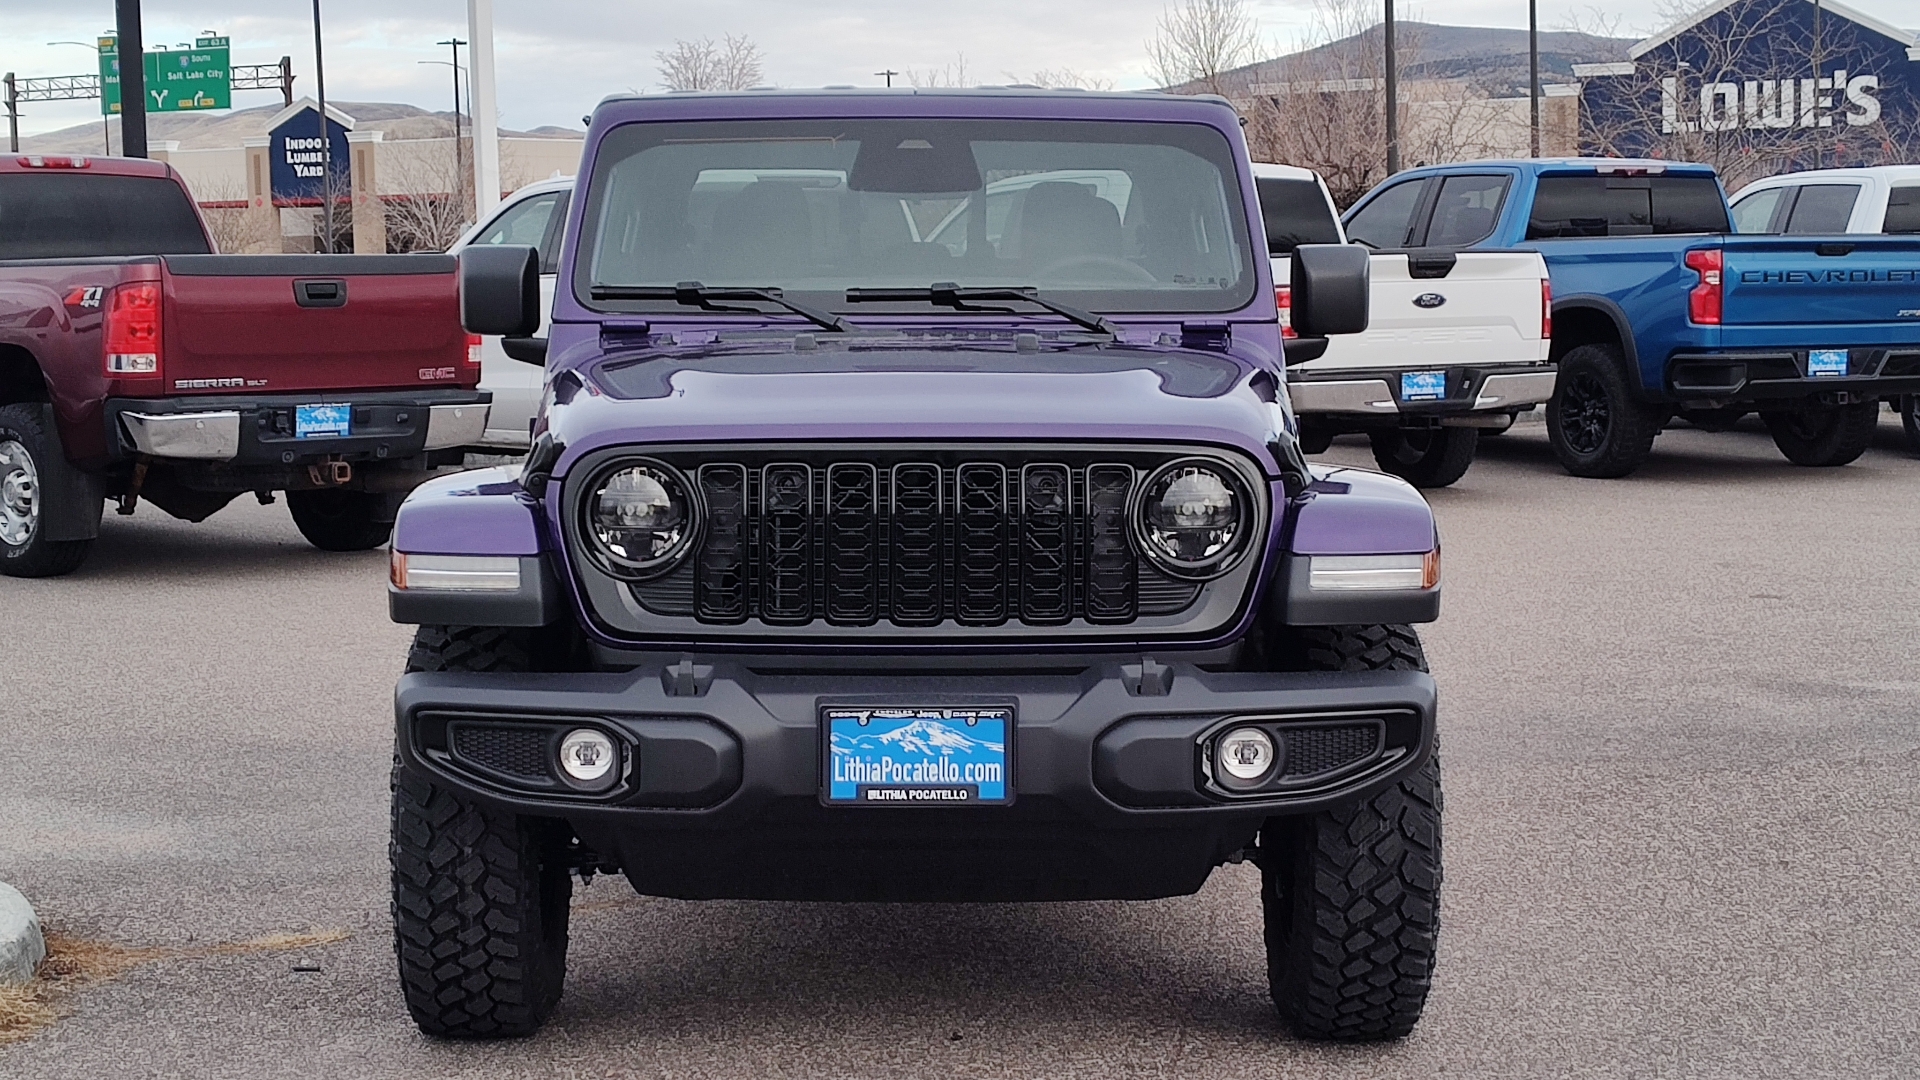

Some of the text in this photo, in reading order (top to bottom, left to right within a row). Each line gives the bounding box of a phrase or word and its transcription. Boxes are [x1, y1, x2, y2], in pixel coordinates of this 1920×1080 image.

[167, 69, 223, 80] Salt Lake City
[1662, 69, 1881, 134] LOWE'S
[294, 164, 324, 177] YARD
[1740, 269, 1920, 285] CHEVROLET
[419, 367, 455, 380] GMC
[175, 378, 244, 388] SIERRA
[834, 755, 1001, 783] LithiaPocatello.com
[876, 789, 968, 800] LITHIA POCATELLO
